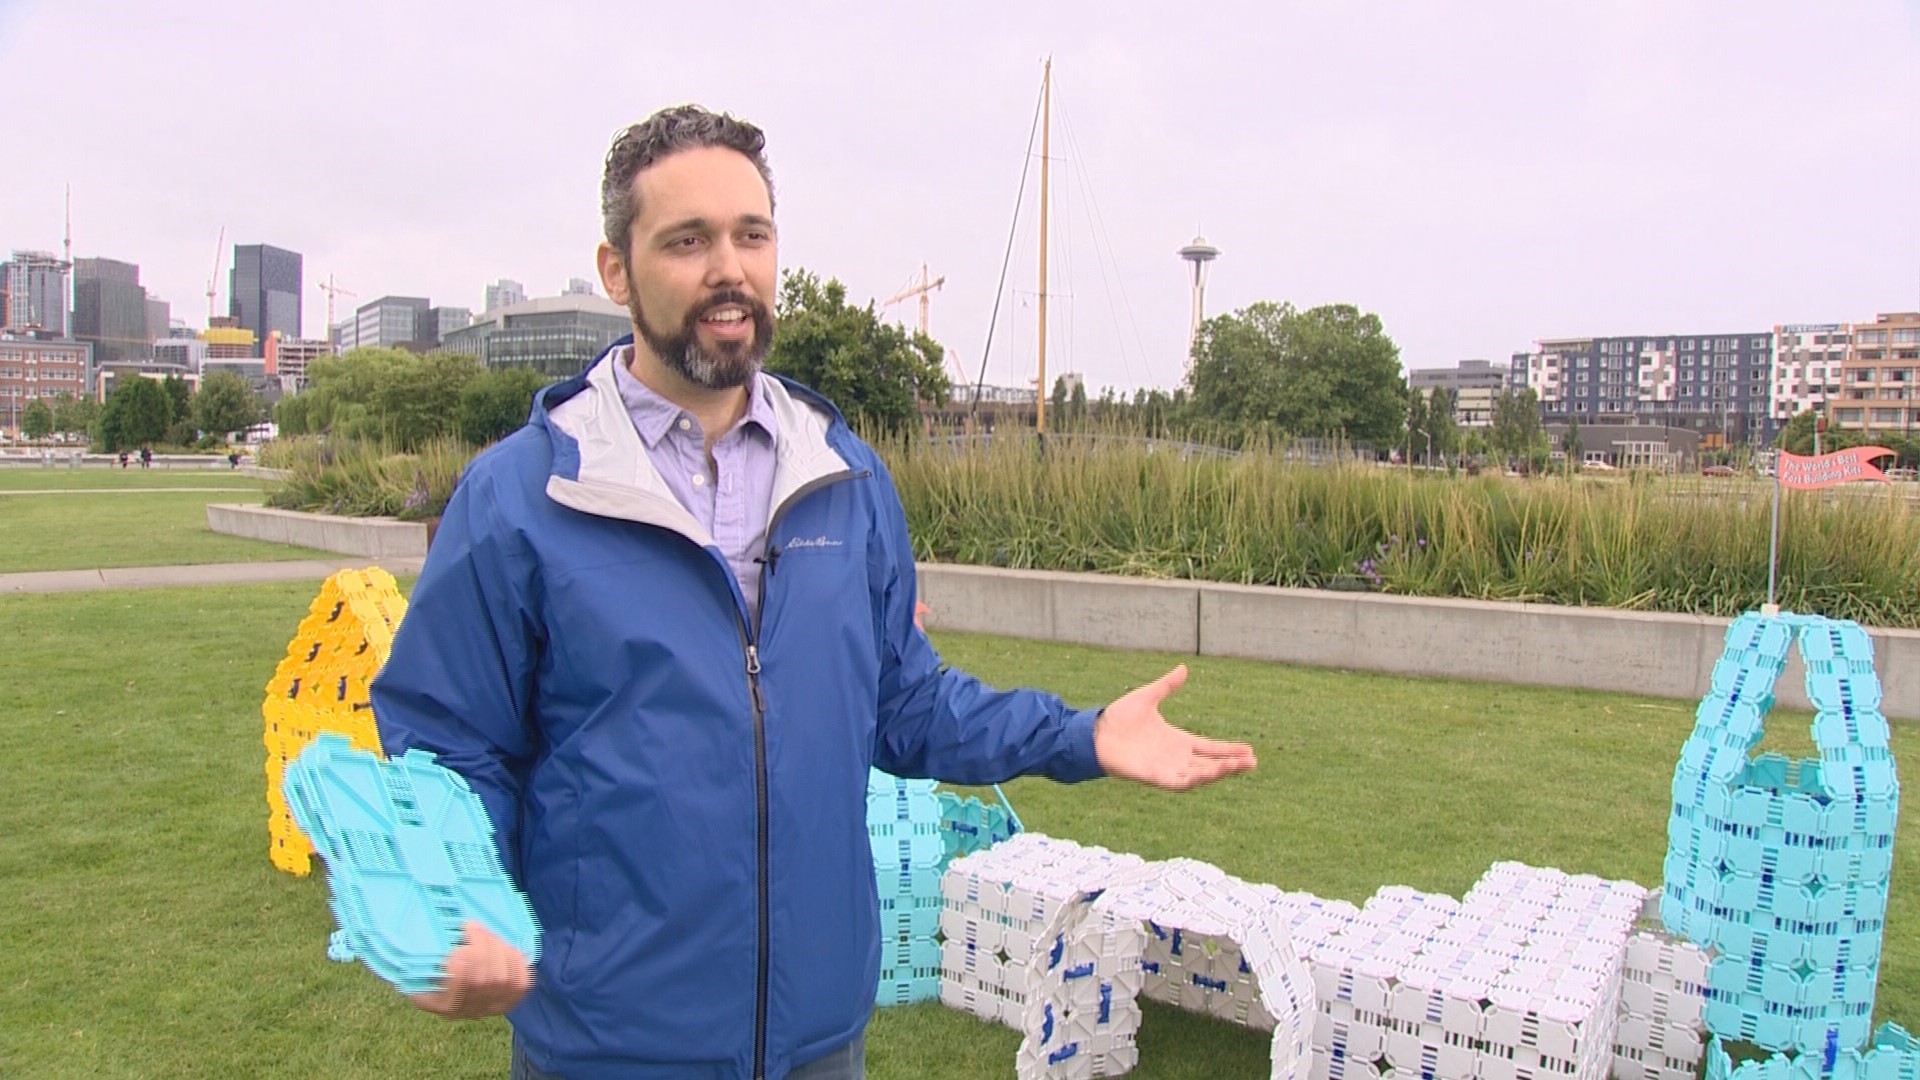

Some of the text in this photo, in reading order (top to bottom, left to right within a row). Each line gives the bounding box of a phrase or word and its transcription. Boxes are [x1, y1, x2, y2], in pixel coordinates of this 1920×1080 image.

[1785, 454, 1857, 472] The World's Best
[1783, 471, 1801, 483] Fort
[1804, 469, 1842, 483] Building
